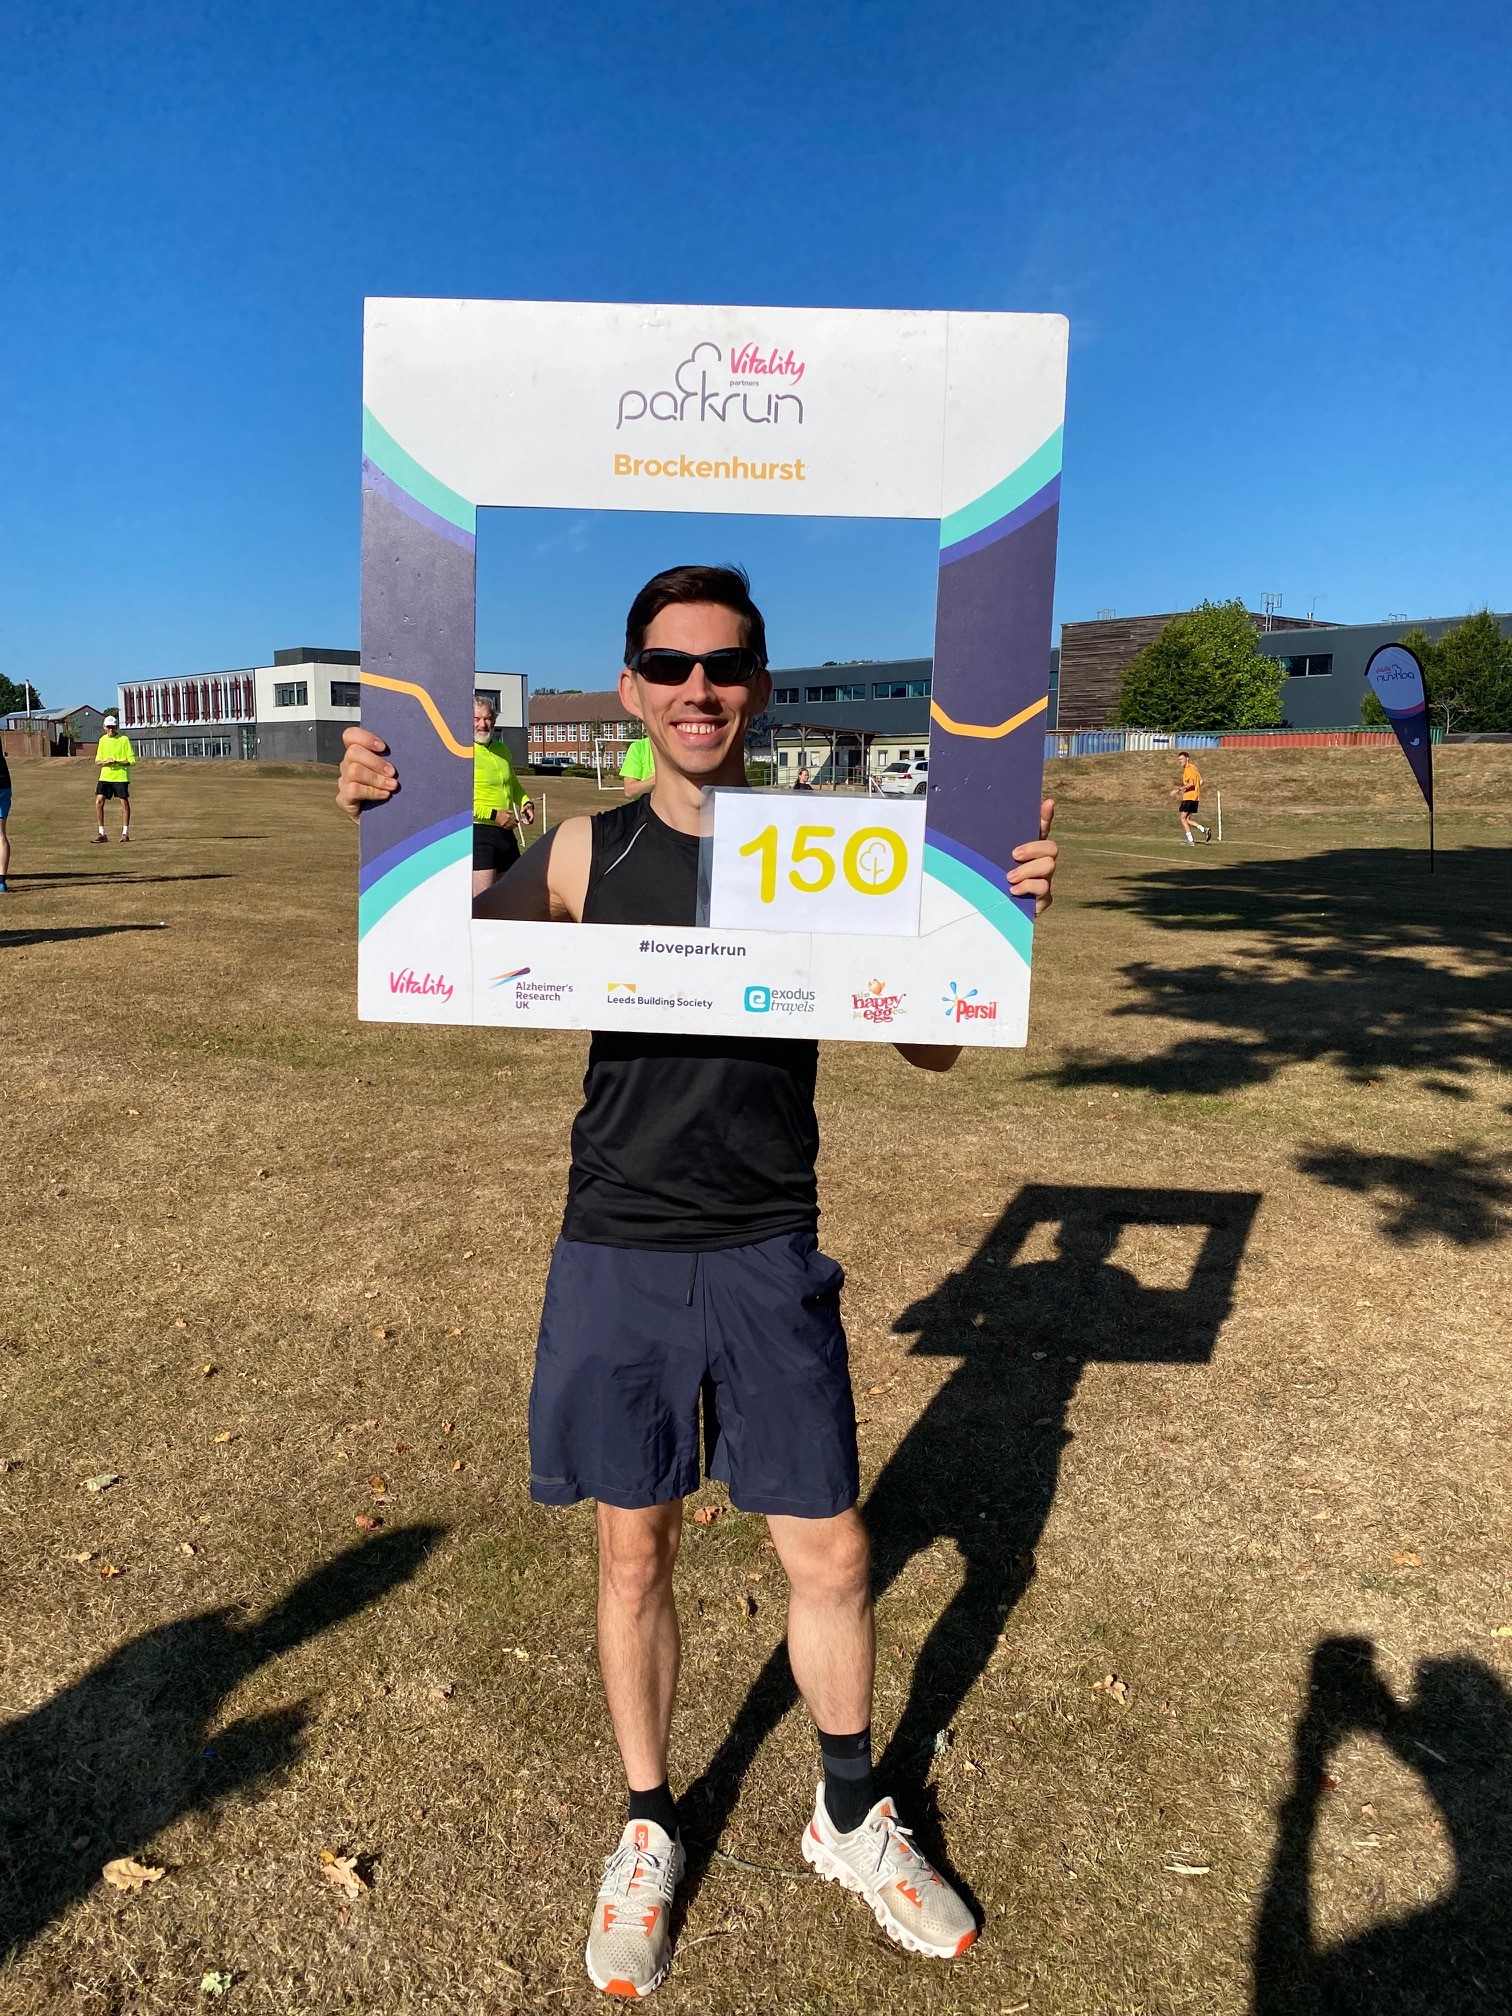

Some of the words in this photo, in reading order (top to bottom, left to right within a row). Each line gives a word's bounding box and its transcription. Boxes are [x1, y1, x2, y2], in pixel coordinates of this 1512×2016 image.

[730, 341, 805, 386] Vitality
[616, 370, 803, 430] parkrun
[614, 453, 806, 481] Brockenhurst
[738, 824, 908, 904] 150
[639, 940, 746, 957] #loveparkrun
[390, 967, 454, 1003] Vitality
[516, 982, 574, 992] Alzheimer's
[516, 991, 561, 1001] Research
[607, 995, 636, 1004] Leeds
[637, 996, 675, 1007] Building
[676, 997, 713, 1009] Society
[771, 988, 816, 1000] exodus
[851, 993, 906, 1009] happy
[515, 1001, 530, 1009] UK
[770, 1000, 815, 1012] travels
[956, 1000, 997, 1023] Persil
[863, 1008, 893, 1023] egg
